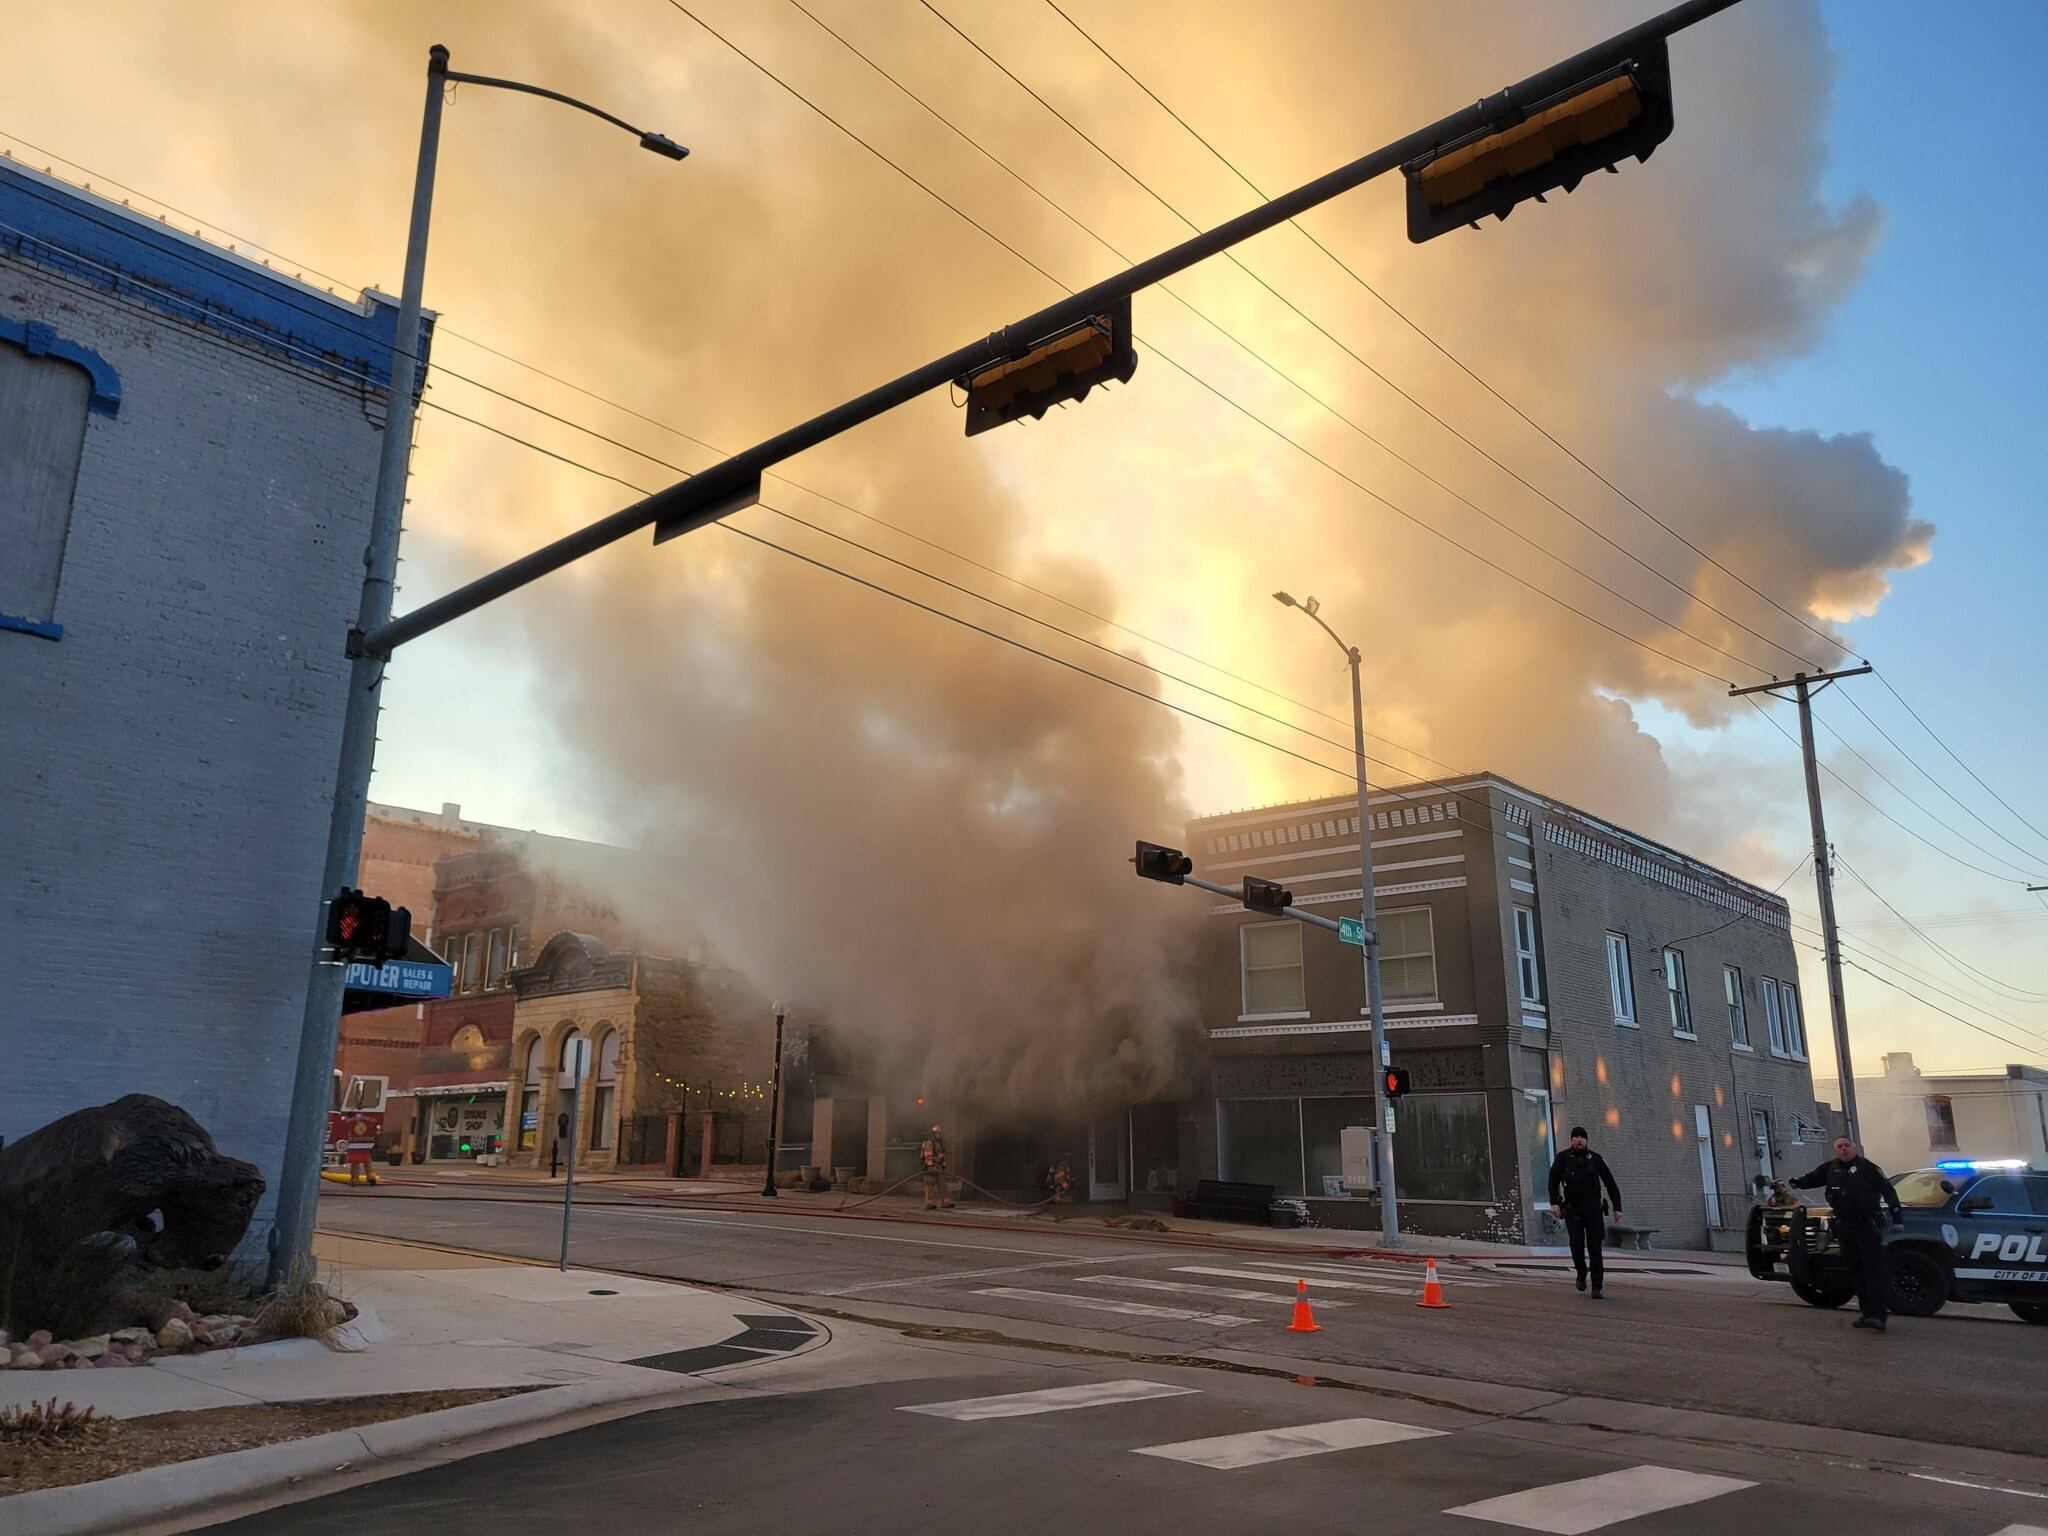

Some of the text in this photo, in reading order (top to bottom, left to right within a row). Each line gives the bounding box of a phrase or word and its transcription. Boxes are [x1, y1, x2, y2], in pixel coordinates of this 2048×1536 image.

[1340, 922, 1353, 937] 4th
[402, 968, 433, 980] SALES &
[402, 979, 432, 991] REPAIR
[463, 1109, 488, 1120] SMOKE
[464, 1121, 484, 1131] SHOP
[1994, 1270, 2019, 1280] CITY
[2021, 1272, 2036, 1280] OF
